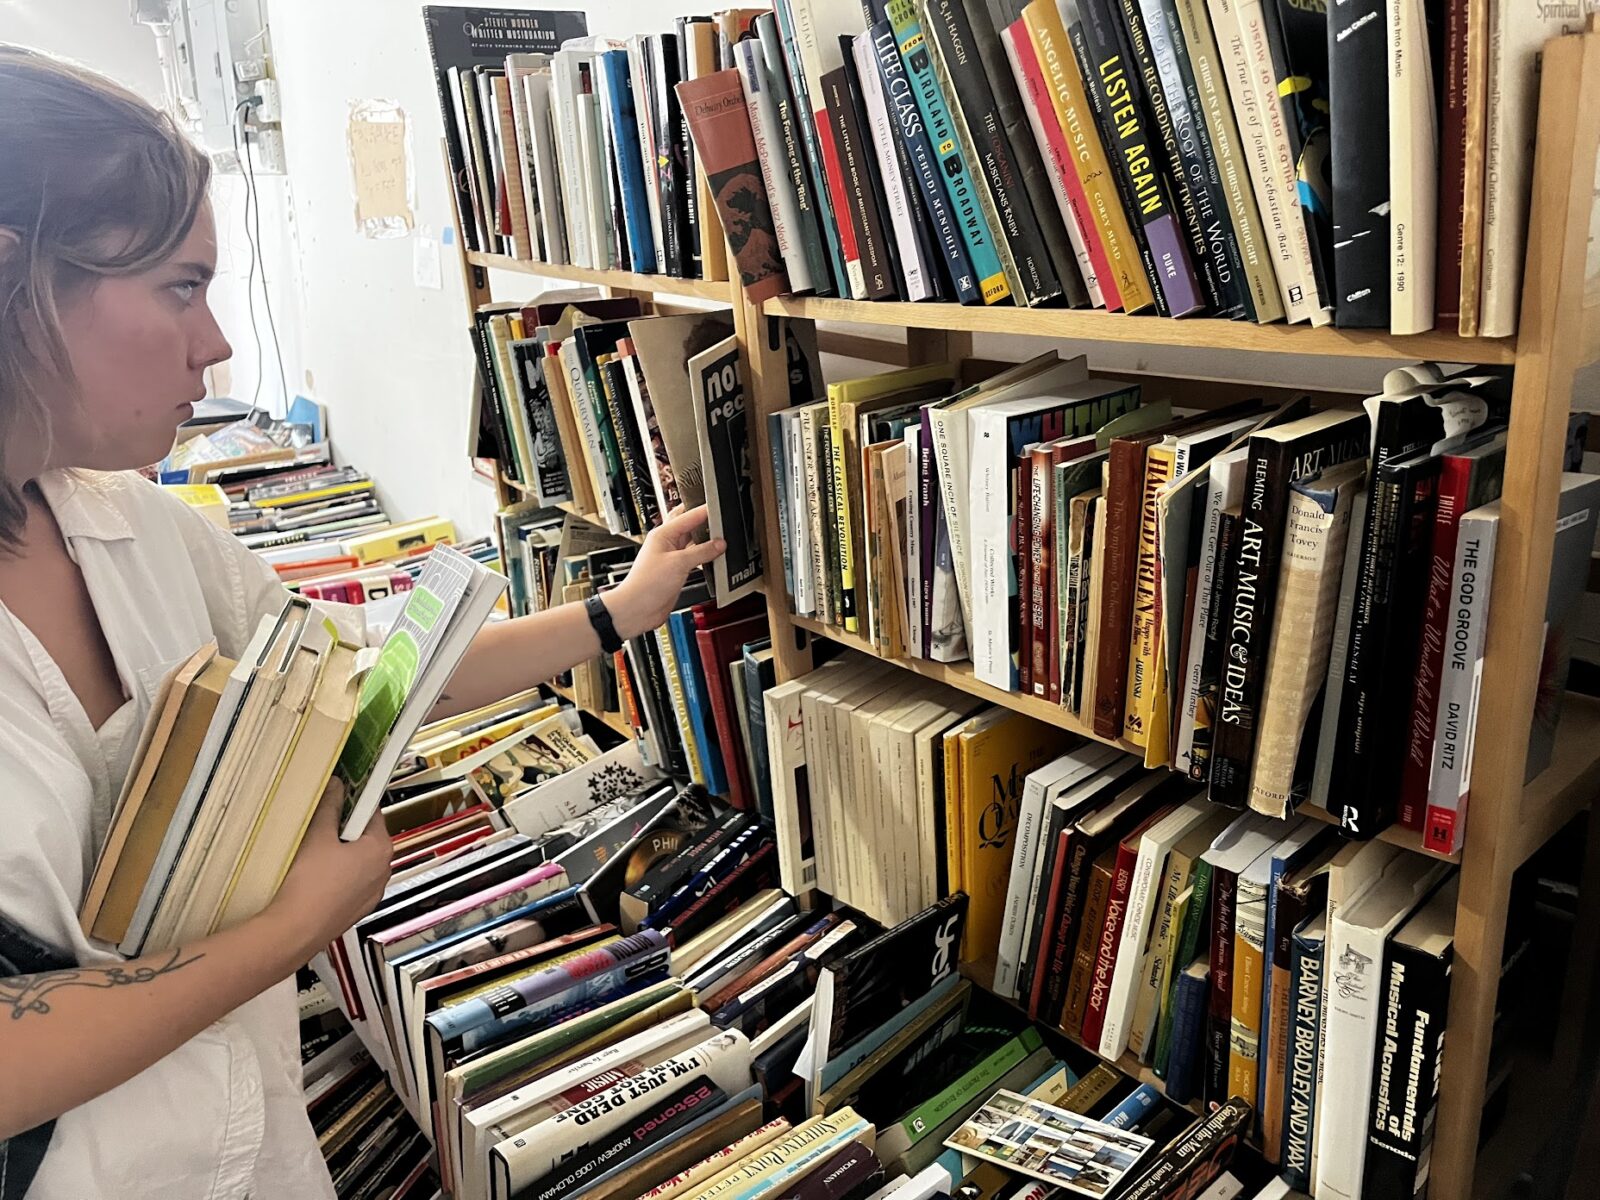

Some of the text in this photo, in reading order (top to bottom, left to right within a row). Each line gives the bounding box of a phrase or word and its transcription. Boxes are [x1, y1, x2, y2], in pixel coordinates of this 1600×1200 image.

[484, 17, 507, 28] STEVIE
[800, 8, 814, 48] ELIJAH
[894, 7, 915, 26] CROW
[904, 35, 924, 51] FROM
[1536, 0, 1581, 22] Spiritual
[948, 23, 967, 65] HAGGIN
[1395, 49, 1403, 78] Music
[779, 100, 788, 119] The
[909, 48, 949, 138] BIRDLAND
[984, 112, 996, 134] THE
[1038, 27, 1090, 163] ANGELIC MUSIC
[1087, 80, 1102, 113] Manifesto
[1129, 16, 1185, 181] Sutton RECORDING THE
[1249, 19, 1295, 192] CHILD'S DREAM OF MUSIC
[783, 120, 796, 159] Forging
[874, 32, 959, 259] LIFE CLASS YEHUDI MENUHIN
[1099, 55, 1140, 140] LISTEN
[1124, 143, 1163, 215] AGAIN
[1147, 10, 1231, 283] BEYOND THE ROOF OF THE WORLD
[1199, 128, 1219, 185] and Happy
[1199, 56, 1259, 266] CHRIST IN EASTERN CHRISTIAN THOUGHT
[1230, 35, 1292, 261] The True Life of Johann Sebastian Bach
[749, 101, 789, 250] Marian McPartland's Jazz World
[793, 168, 804, 186] the
[943, 152, 984, 247] BROADWAY
[985, 152, 1019, 237] MUSICIANS KNEW
[1486, 172, 1498, 227] Christianity
[849, 167, 877, 267] BOOK WISDOM
[1094, 192, 1121, 260] COREY MEAD
[1026, 256, 1042, 290] HORIZON
[1162, 252, 1177, 279] DUKE
[1396, 223, 1405, 292] Genre 1990
[985, 285, 1004, 298] OXFORD
[571, 367, 596, 449] QUARRYMEN
[1177, 448, 1186, 460] No
[833, 446, 848, 570] THE CLASSICAL REVOLUTION
[937, 420, 964, 556] ONE SQUARE INCH OF SILENCE
[1291, 505, 1325, 520] Donald
[1437, 494, 1455, 525] THIELE
[1289, 519, 1323, 535] Francis
[1289, 533, 1319, 551] Tovey
[731, 561, 756, 587] mail
[1136, 545, 1155, 615] ARLEN
[1198, 491, 1223, 629] We Gotta Get Out This Place
[1221, 458, 1268, 725] FLEMING ART, MUSIC & IDEAS
[1451, 538, 1480, 671] THE GOD GROOVE
[661, 633, 690, 731] DREAM COLONY
[1411, 555, 1450, 768] What a Wonderful World
[1441, 702, 1461, 771] DAVID RITZ
[1018, 812, 1033, 869] DECOMPOSITION
[1052, 844, 1086, 976] Change Your Voice Change Your Life
[1159, 870, 1182, 940] My Life and Music
[1089, 868, 1129, 1012] BERRY Voice and the Actor
[1287, 955, 1320, 1173] BARNEY, BRADLEY, AND MAX
[1375, 960, 1405, 1131] Musical Acoustics
[1401, 1009, 1431, 1142] Fundamentals
[553, 1059, 678, 1124] I'M NOT GONE
[574, 1057, 701, 1126] I'M JUST DEAD
[633, 1085, 713, 1141] 2Stoned
[784, 1119, 838, 1153] SHIFTING
[1176, 1105, 1238, 1158] Gandhi the Man
[1370, 1135, 1416, 1161] Benade
[1388, 1114, 1400, 1138] of
[538, 1136, 632, 1200] ANDREW LOOG OLDHAM
[743, 1152, 785, 1179] POINT
[1151, 1162, 1174, 1182] Eknath
